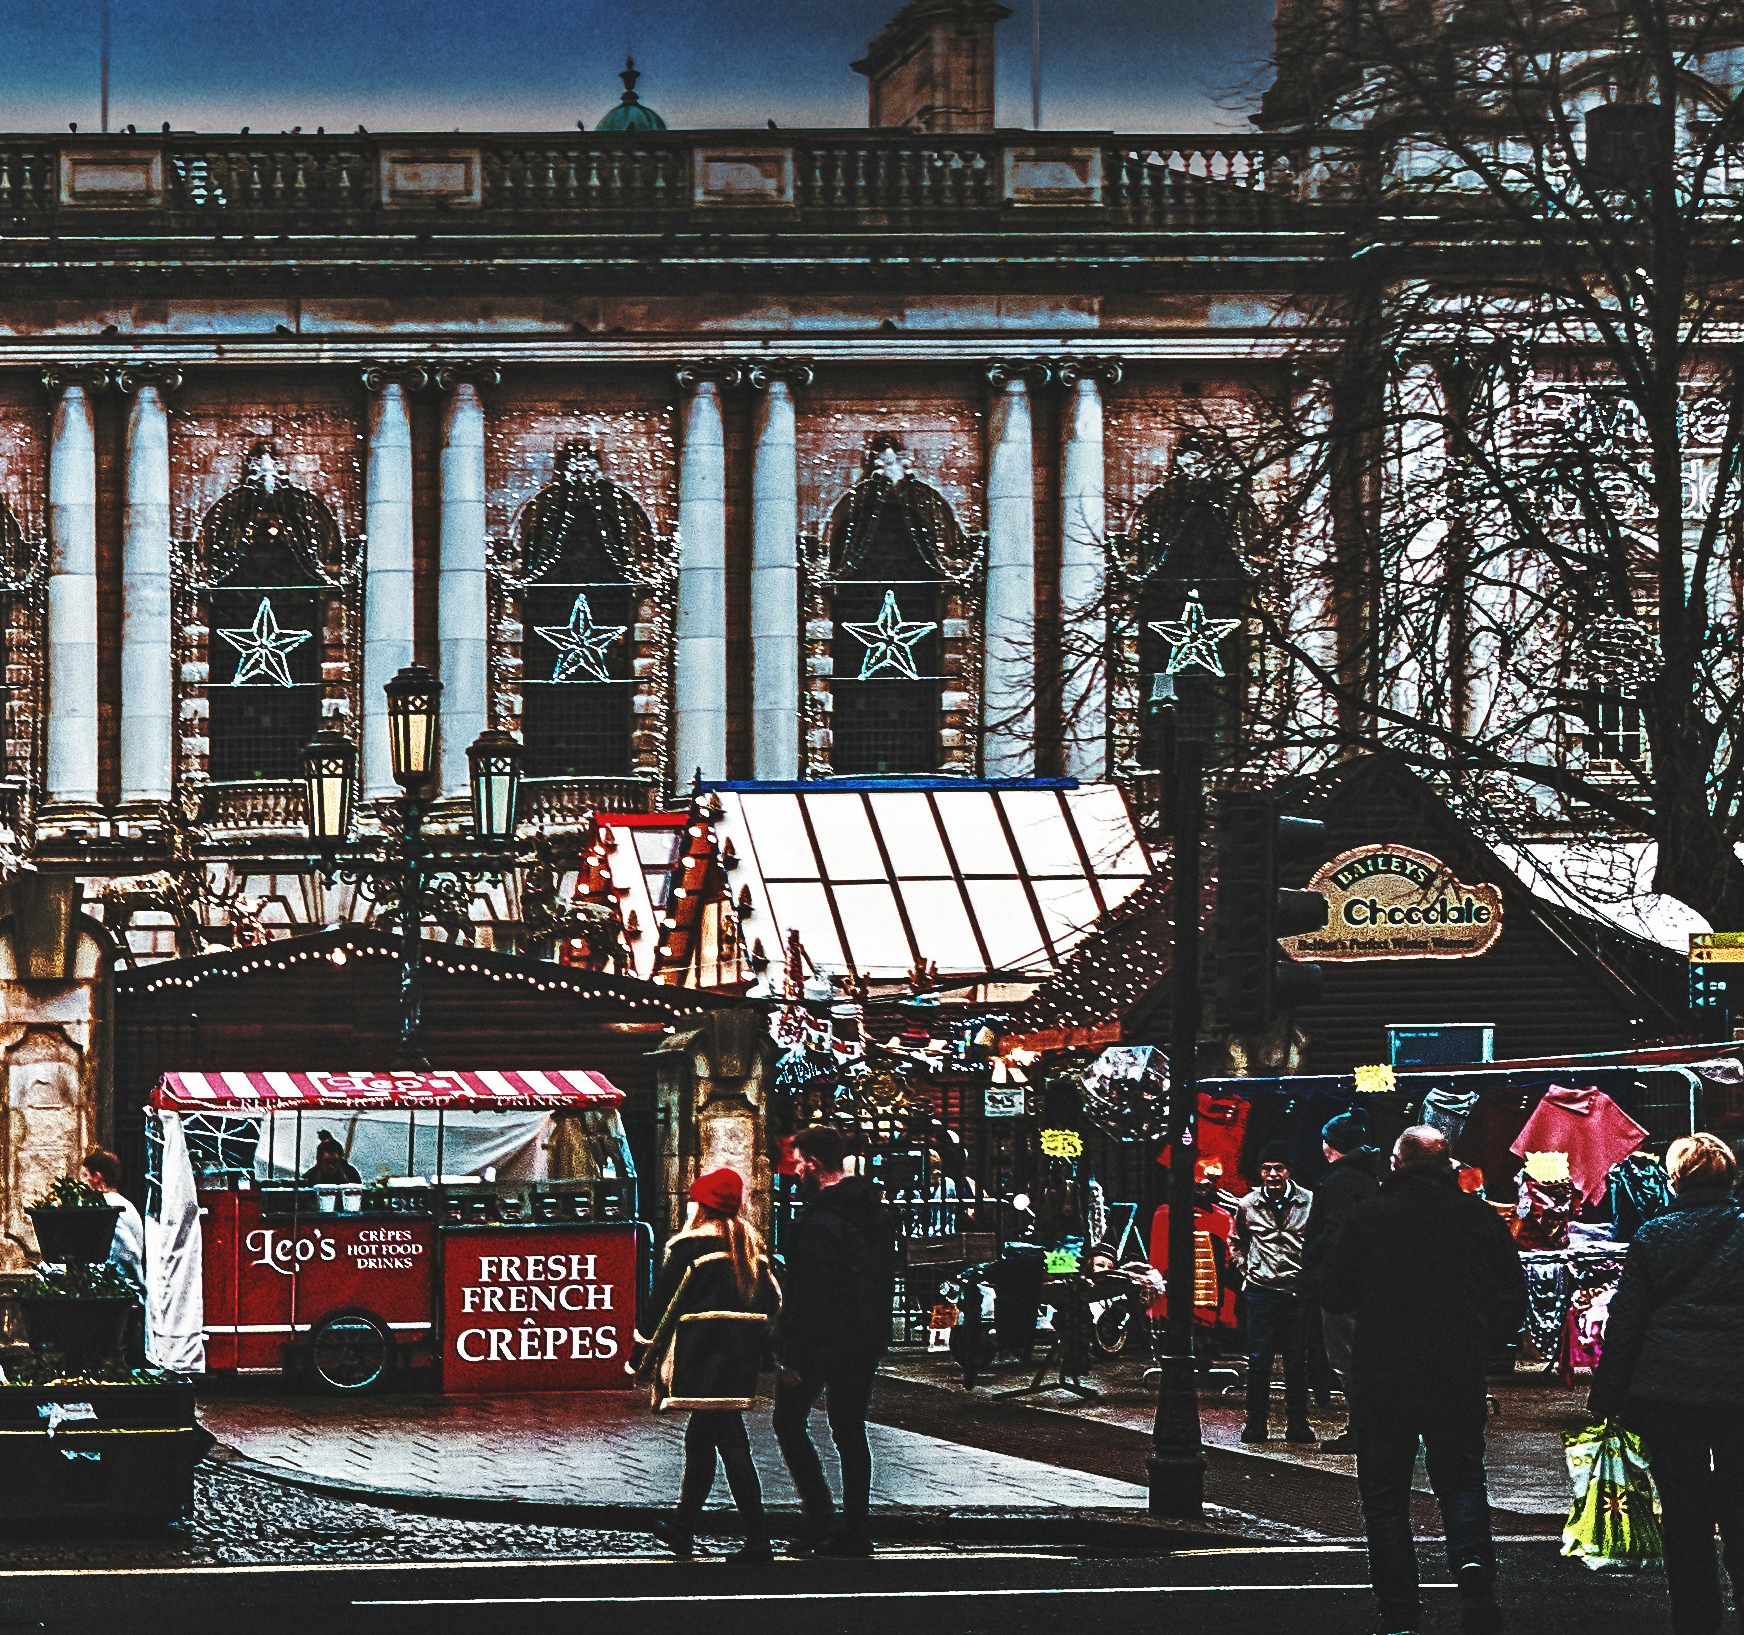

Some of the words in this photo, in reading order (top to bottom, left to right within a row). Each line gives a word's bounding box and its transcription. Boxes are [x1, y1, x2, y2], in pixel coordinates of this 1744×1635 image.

[1336, 856, 1430, 886] BAILEYS
[1343, 896, 1492, 926] Chocolate
[245, 1228, 337, 1275] Leo's
[347, 1244, 379, 1256] HOT
[382, 1243, 423, 1256] FOOD
[356, 1257, 414, 1270] DRINKS
[478, 1254, 598, 1282] FRESH
[462, 1284, 614, 1313] FRENCH
[456, 1317, 618, 1362] CRÊPES
